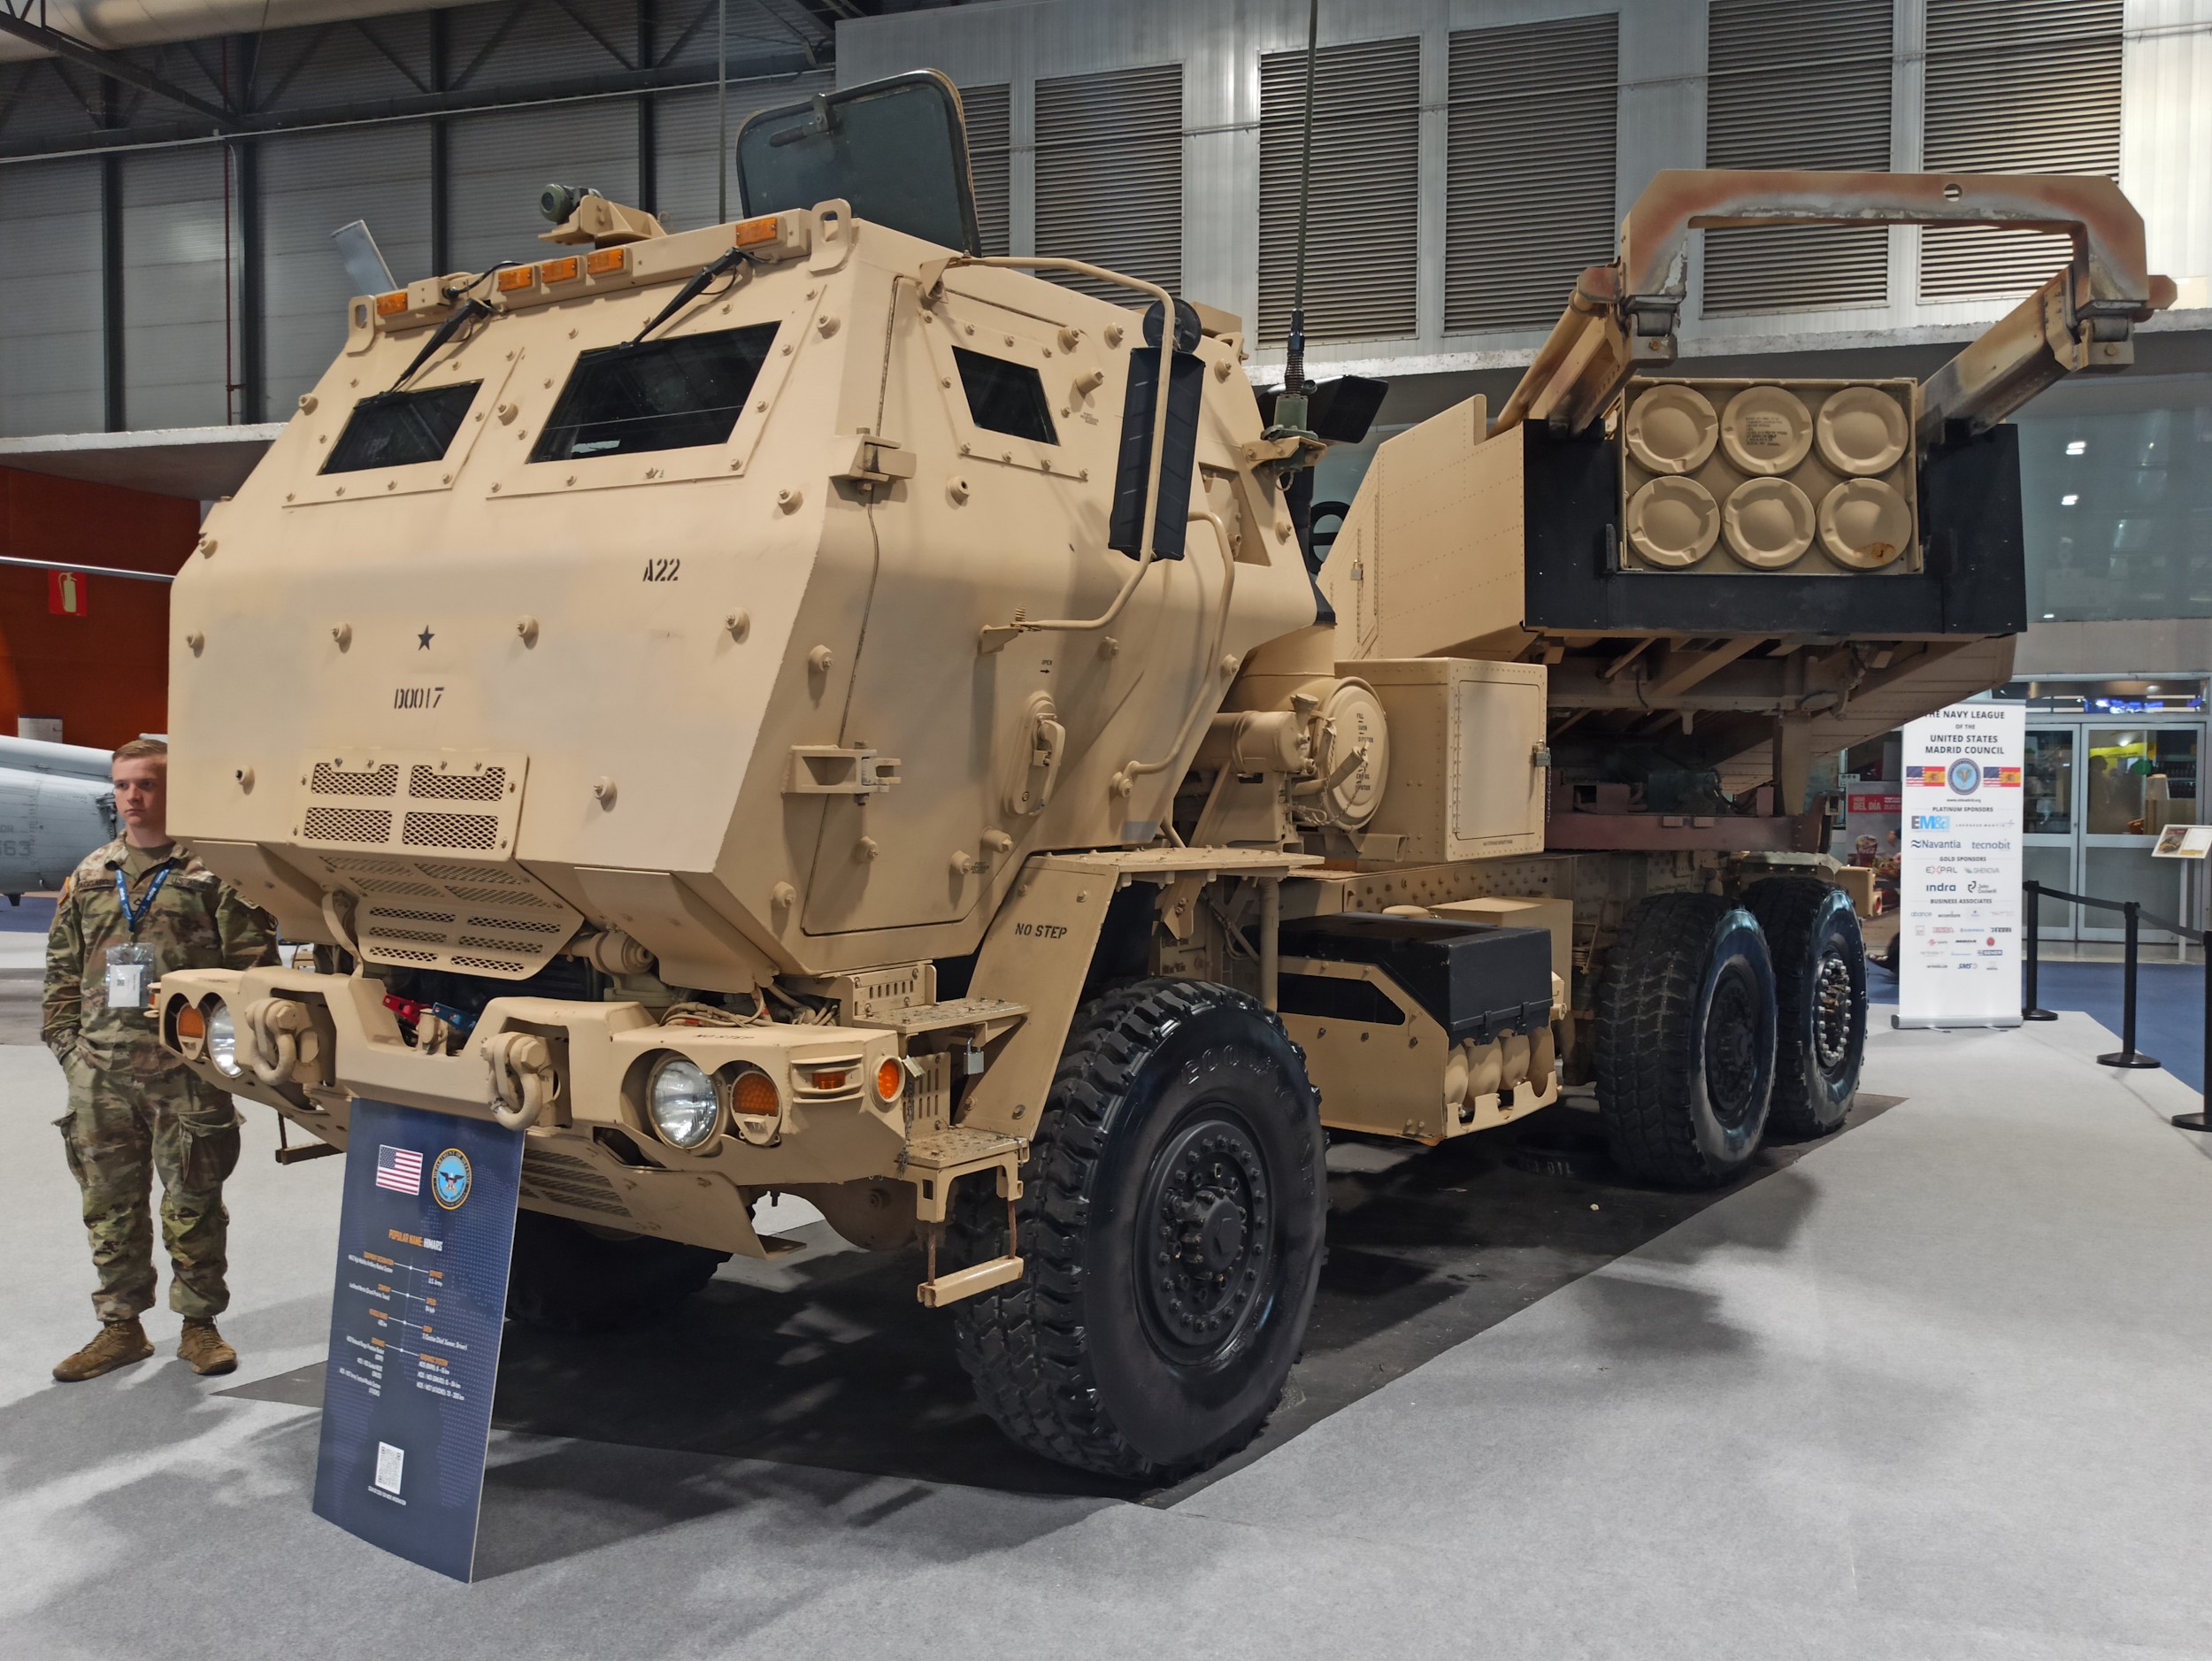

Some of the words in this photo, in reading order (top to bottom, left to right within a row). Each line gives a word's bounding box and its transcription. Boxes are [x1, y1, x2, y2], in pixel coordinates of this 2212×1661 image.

[642, 558, 681, 581] A22
[394, 687, 444, 709] D0017
[1964, 746, 2005, 755] COUNCIL
[1922, 840, 1961, 849] Navantia
[1972, 840, 2010, 850] tecnobit
[1925, 865, 1958, 874] EXPAL
[1925, 882, 1956, 892] indra
[1015, 923, 1033, 935] NO
[1035, 925, 1068, 939] STEP
